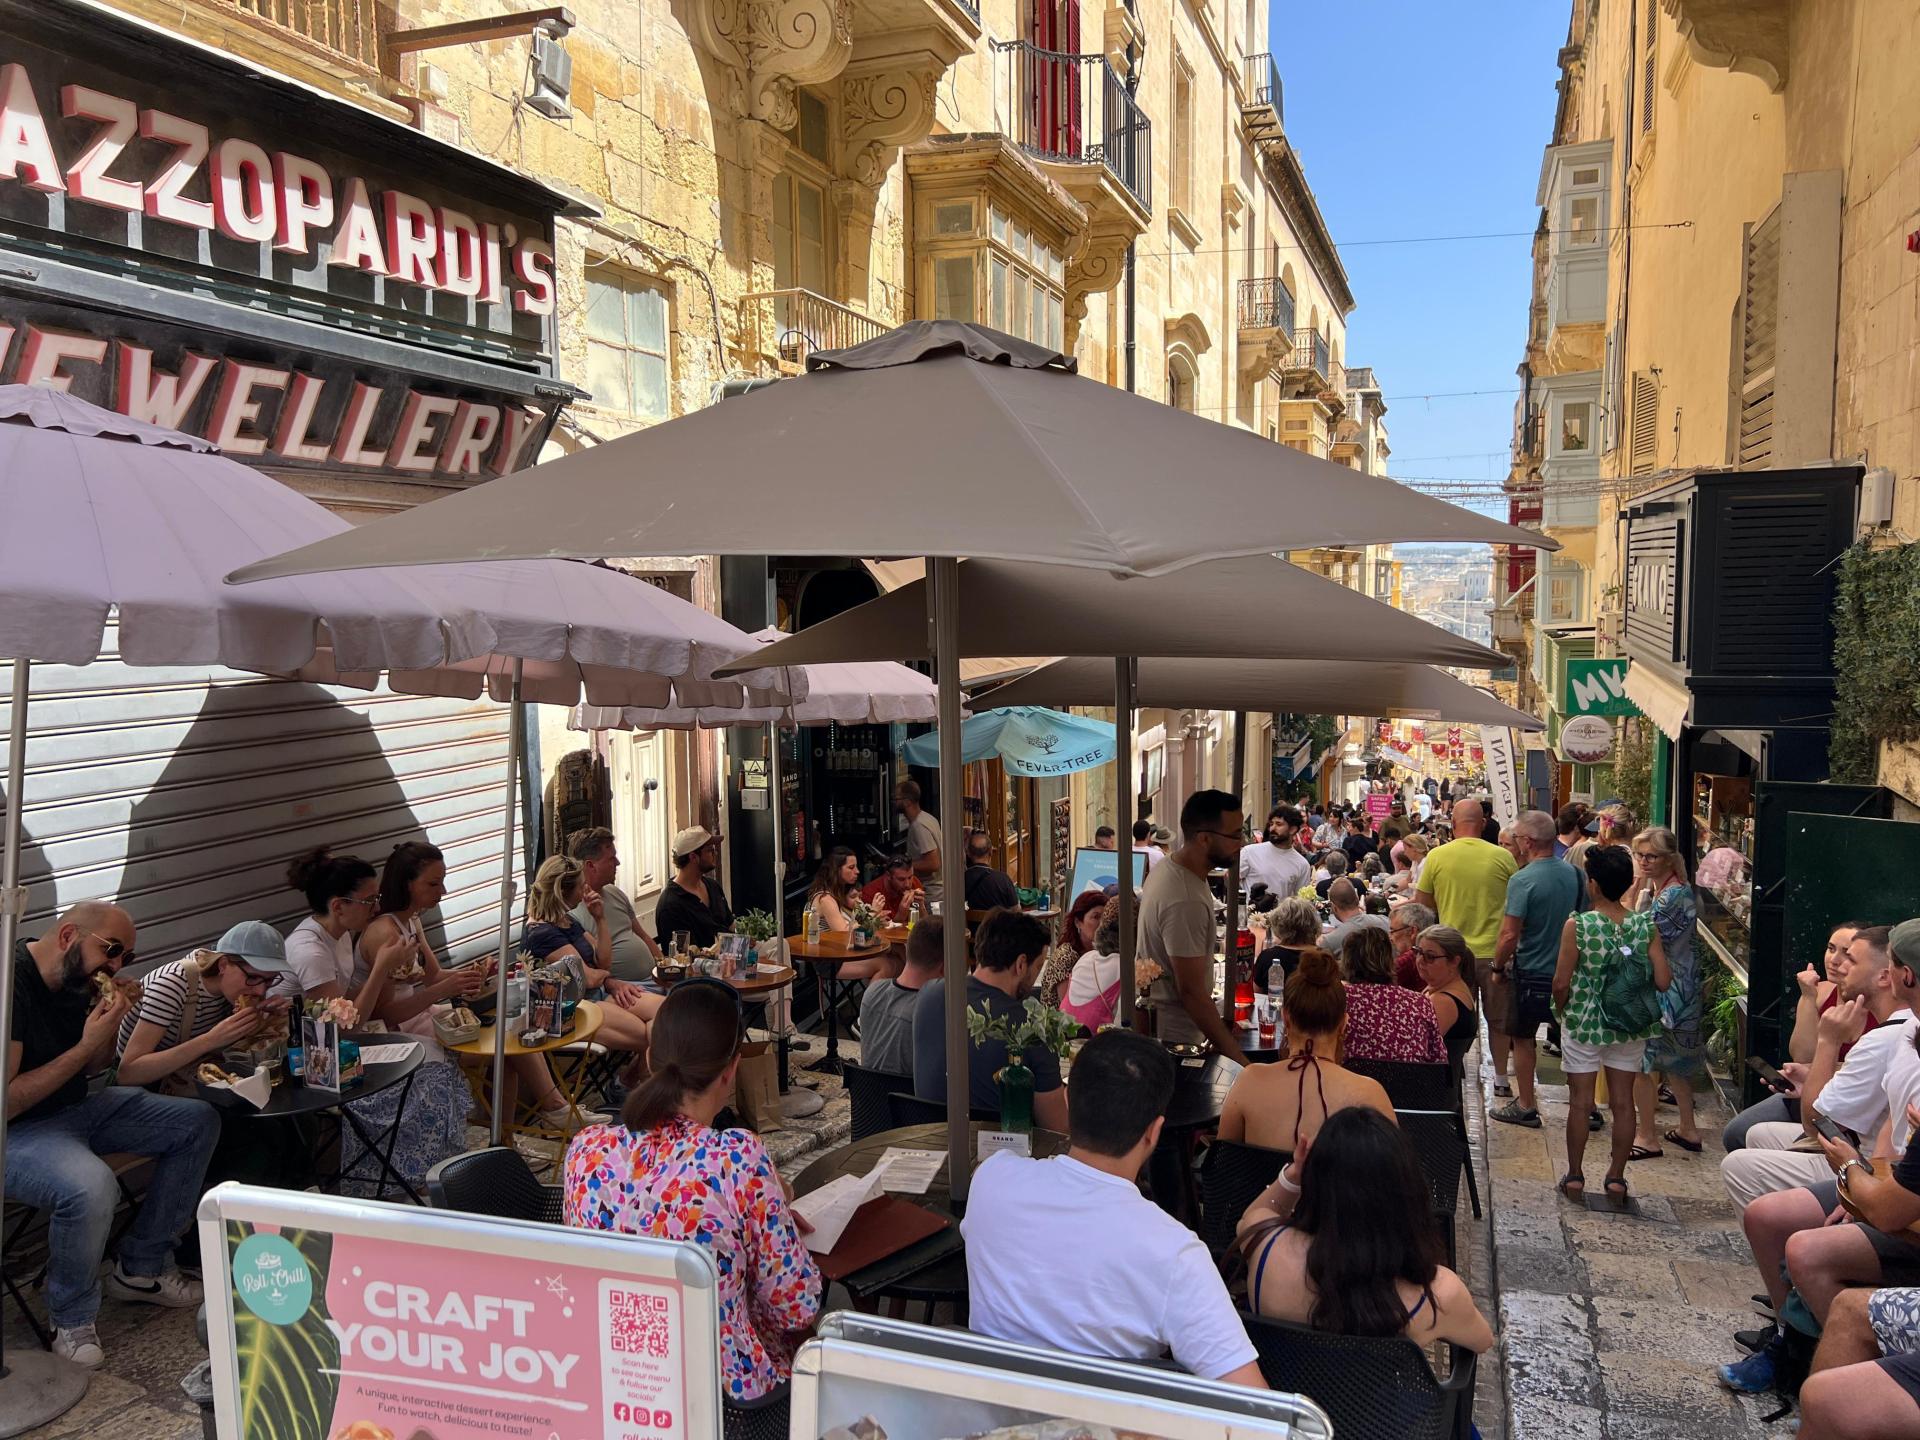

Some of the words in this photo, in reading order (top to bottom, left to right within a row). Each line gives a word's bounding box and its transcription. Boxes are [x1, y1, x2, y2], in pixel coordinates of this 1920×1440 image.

[0, 62, 554, 316] AZZOPARDI'S
[0, 320, 545, 477] EWELLERY
[1571, 664, 1625, 711] MV
[1016, 749, 1103, 772] FEVER-TREE
[243, 1273, 269, 1293] Roll
[276, 1267, 306, 1288] Chill
[363, 1280, 535, 1337] CRAFT
[324, 1319, 467, 1375] YOUR
[478, 1342, 580, 1389] JOY
[621, 1358, 641, 1368] Scan
[641, 1361, 660, 1371] here
[611, 1367, 620, 1375] to
[621, 1369, 634, 1377] see
[648, 1374, 671, 1382] menu
[619, 1379, 625, 1387] &
[626, 1379, 648, 1390] follow
[356, 1386, 364, 1395] A
[365, 1388, 400, 1403] unique,
[401, 1393, 454, 1411] interactive
[456, 1402, 493, 1418] dessert
[495, 1409, 553, 1427] experience.
[627, 1391, 656, 1401] socials!
[377, 1402, 396, 1414] Fun
[398, 1405, 408, 1416] to
[409, 1407, 442, 1423] watch,
[444, 1413, 488, 1430] delicious
[490, 1421, 501, 1432] to
[502, 1425, 533, 1437] taste!
